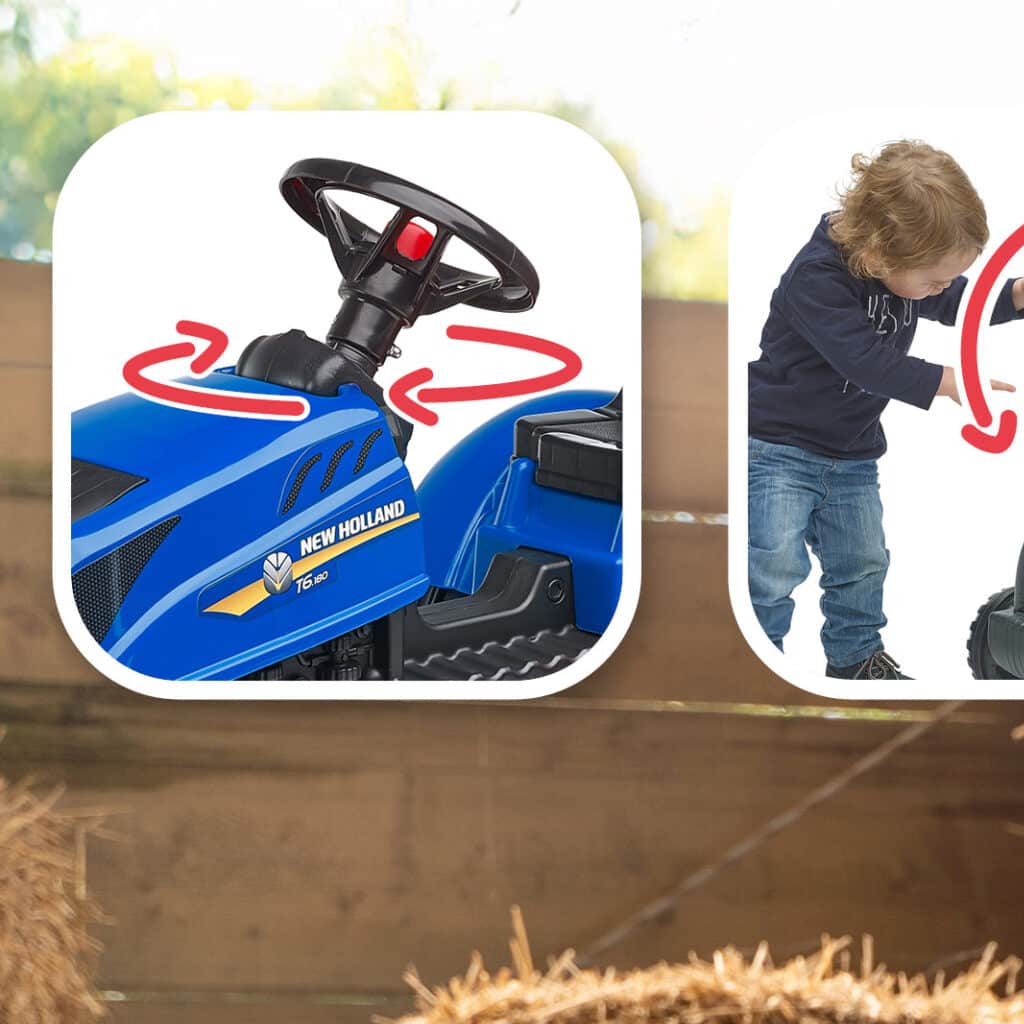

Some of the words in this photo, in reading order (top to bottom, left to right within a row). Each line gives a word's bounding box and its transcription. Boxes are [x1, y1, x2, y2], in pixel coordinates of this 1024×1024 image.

[300, 522, 336, 557] NEW
[338, 498, 405, 540] HOLLAND
[295, 570, 329, 595] T6.180
